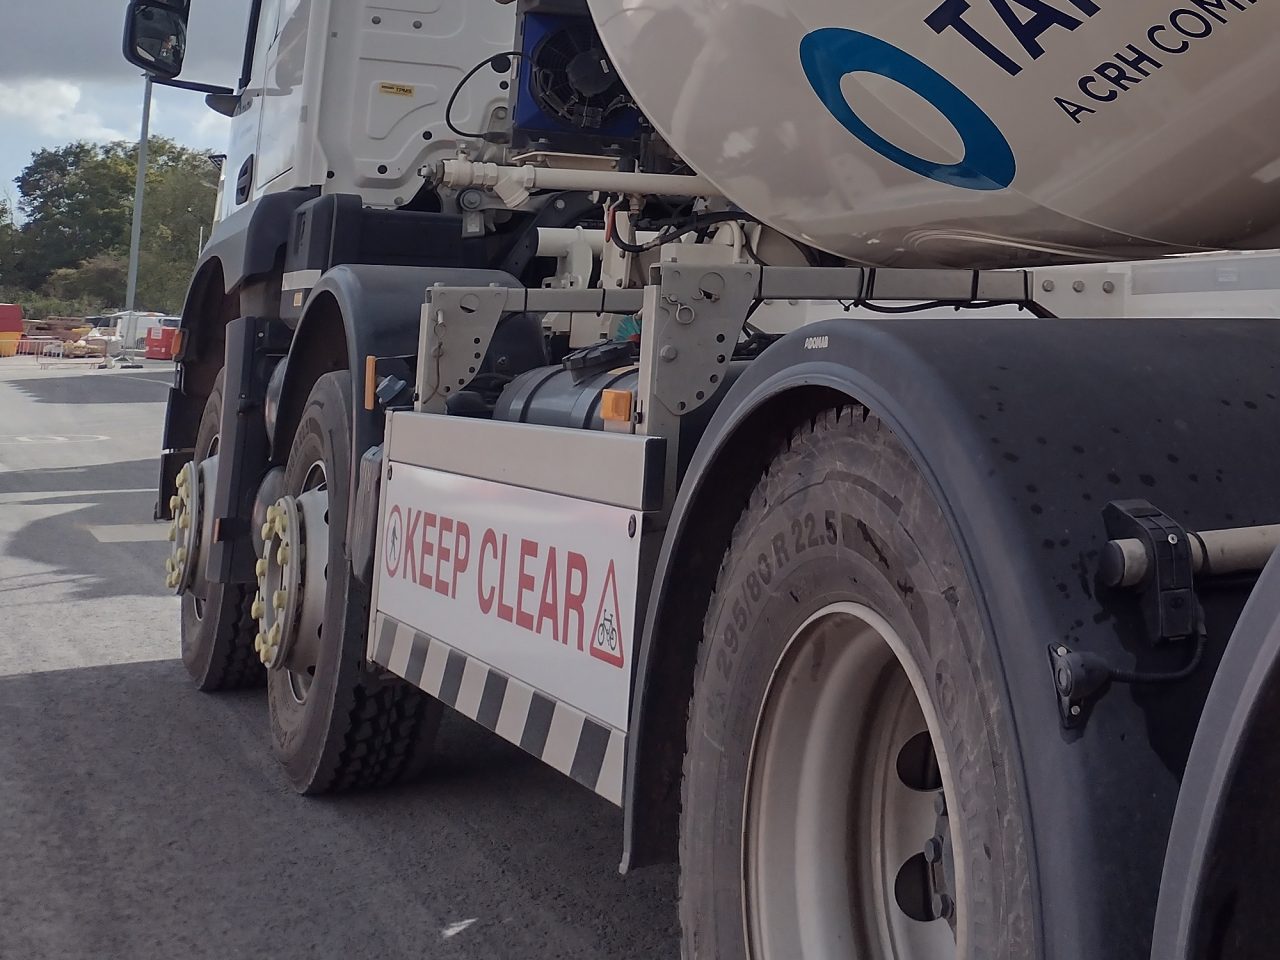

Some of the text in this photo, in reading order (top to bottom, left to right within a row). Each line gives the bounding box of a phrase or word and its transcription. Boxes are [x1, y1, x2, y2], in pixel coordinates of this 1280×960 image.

[1053, 96, 1097, 124] A
[1077, 43, 1163, 102] CRH
[791, 509, 838, 554] 22.5
[402, 506, 588, 652] KEEP CLEAR
